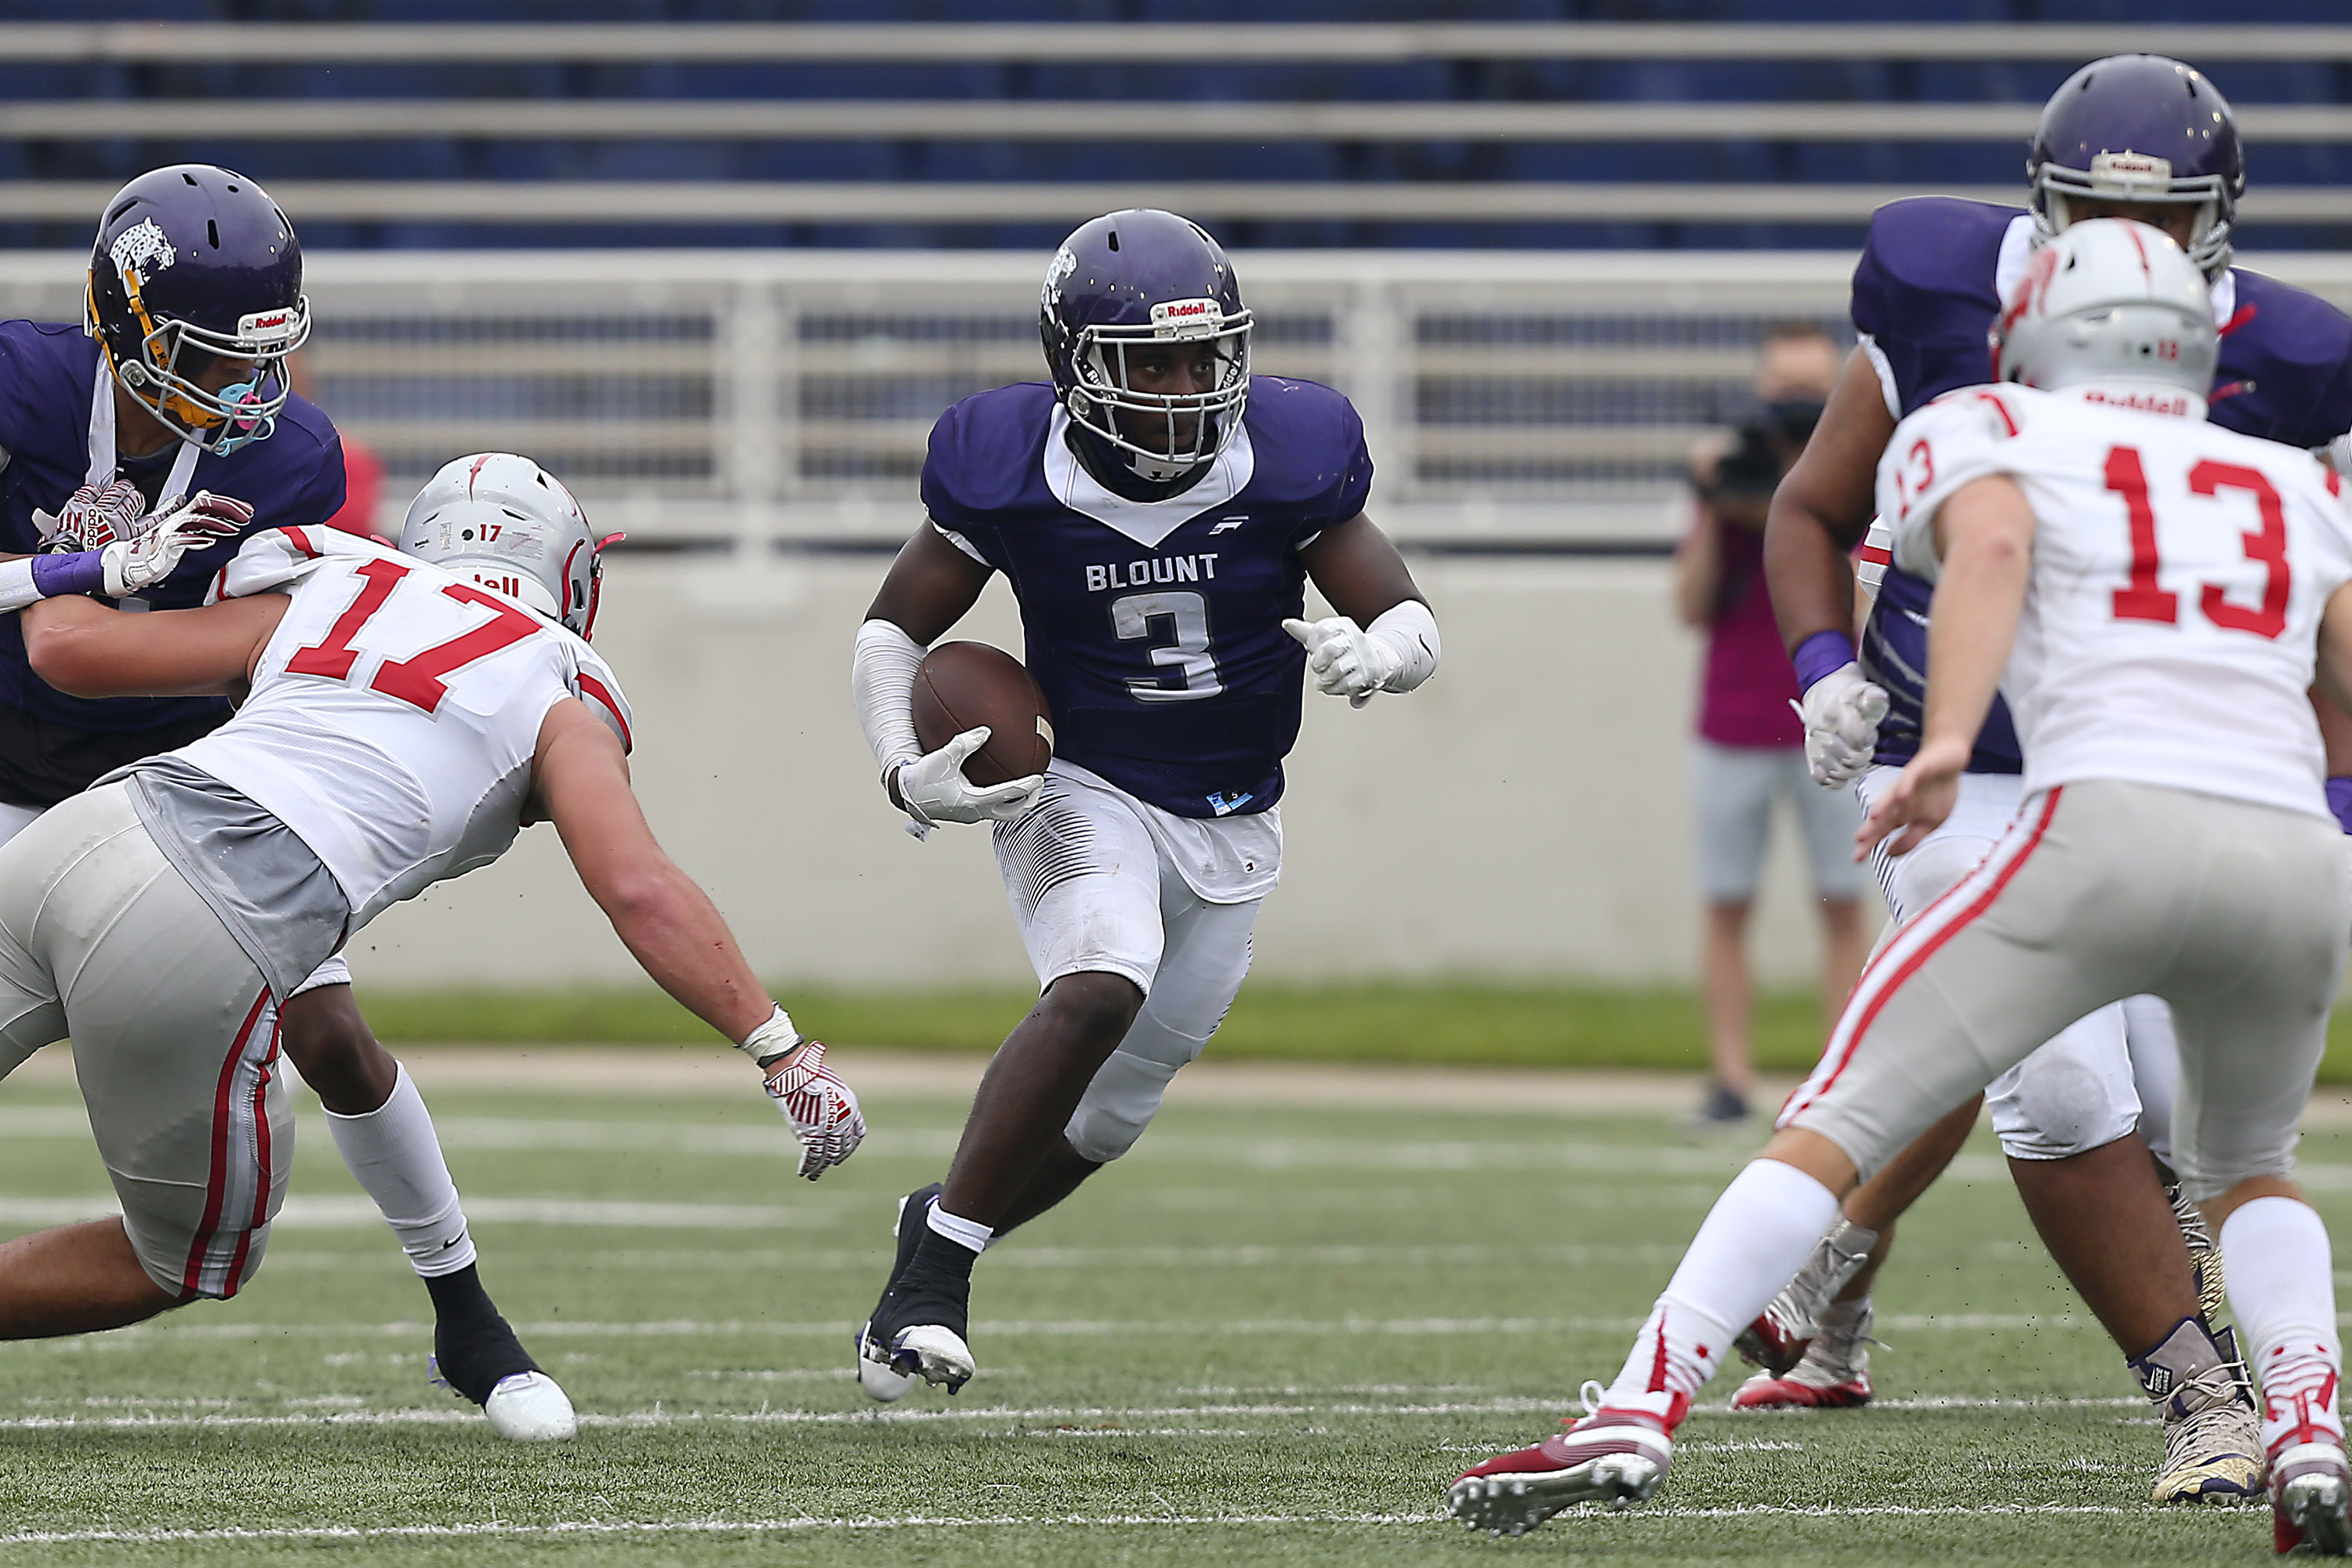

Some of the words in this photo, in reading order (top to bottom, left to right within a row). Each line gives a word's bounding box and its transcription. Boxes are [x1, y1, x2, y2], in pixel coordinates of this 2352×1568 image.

[255, 314, 287, 328] Riddell
[1167, 302, 1206, 317] Riddell
[480, 524, 503, 542] 17
[2103, 445, 2291, 639] 13
[1086, 554, 1218, 592] BLOUNT
[280, 557, 544, 721] 17
[1110, 590, 1225, 702] 3
[826, 1087, 837, 1131] adidas
